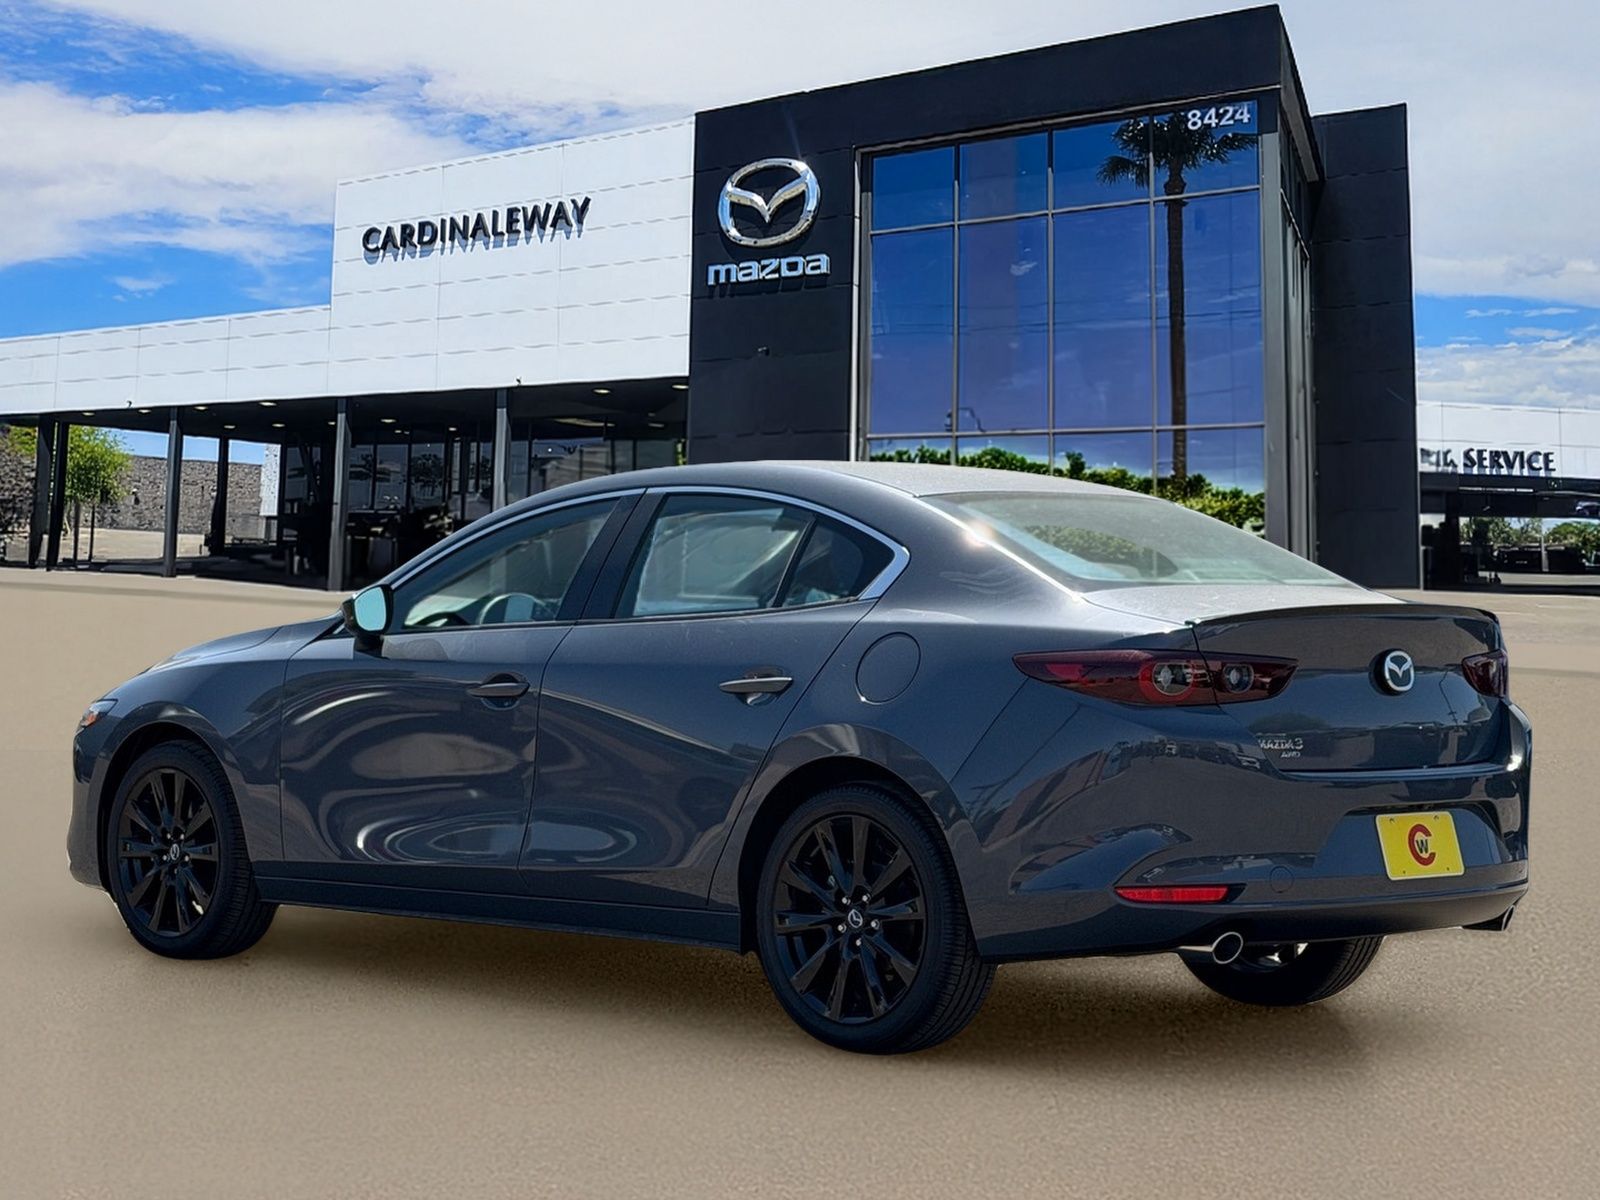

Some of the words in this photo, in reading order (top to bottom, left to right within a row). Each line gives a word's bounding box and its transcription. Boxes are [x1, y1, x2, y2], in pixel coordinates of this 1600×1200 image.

[1187, 103, 1251, 130] 8424
[362, 196, 592, 253] CARDINALEWAY
[707, 253, 830, 286] mazda
[1462, 447, 1557, 472] SERVICE
